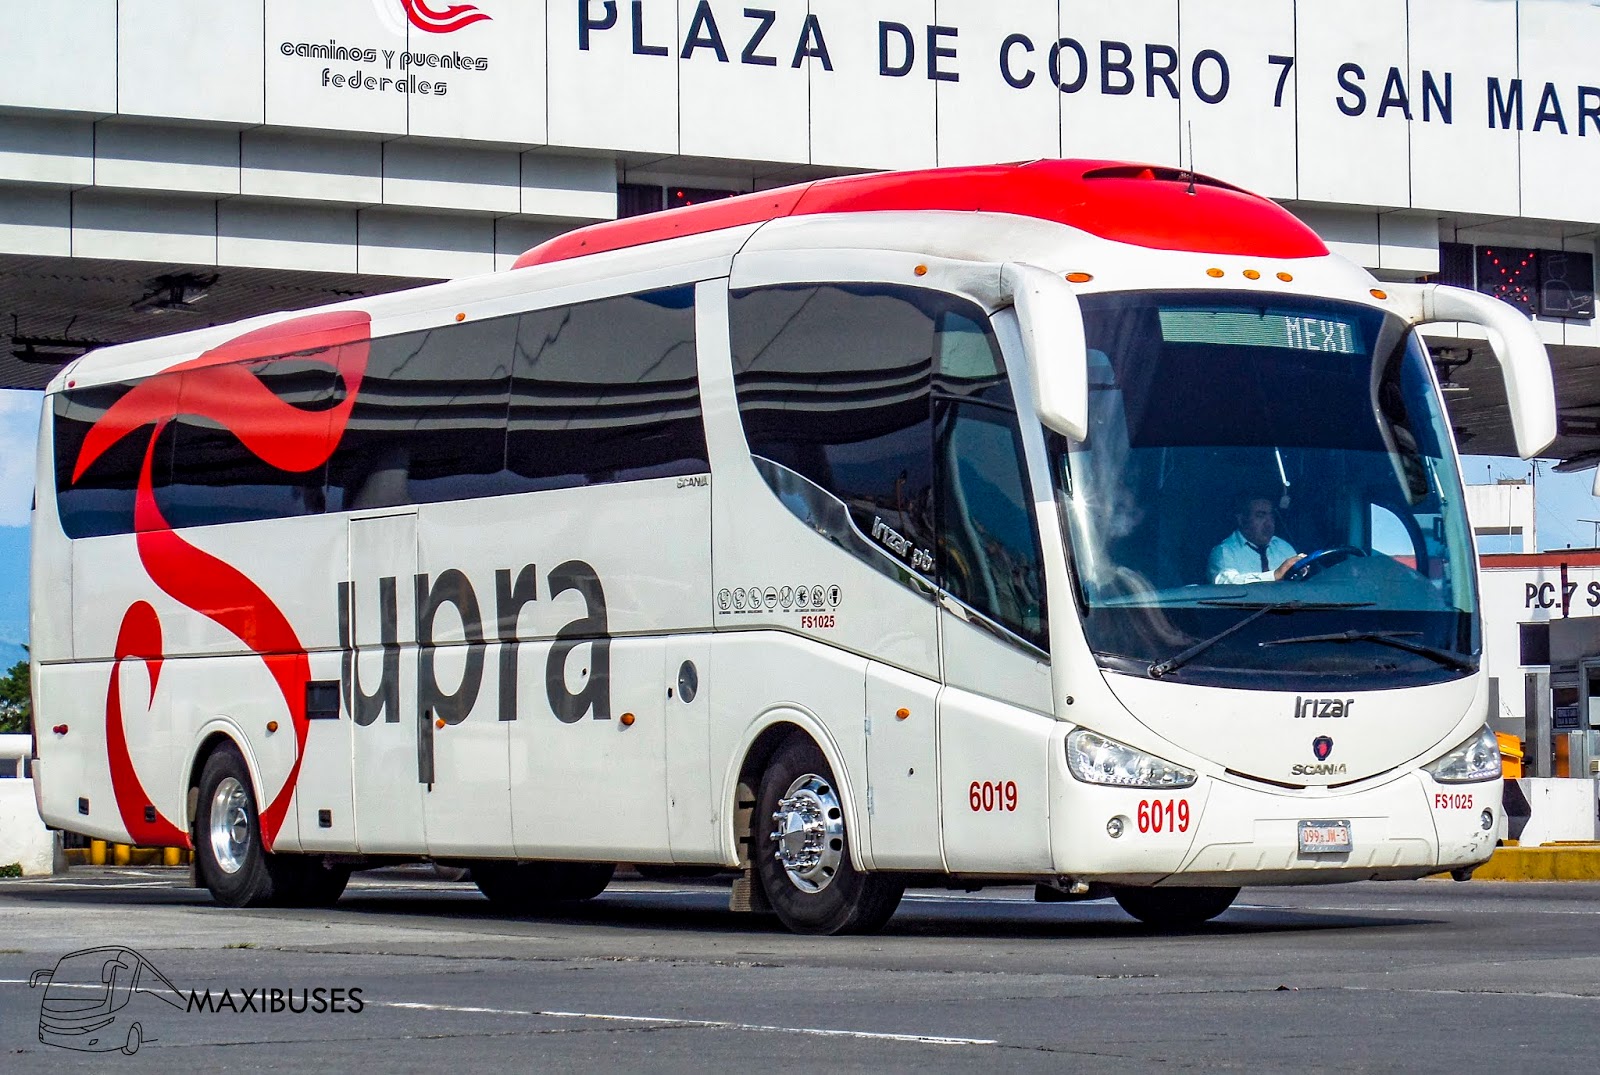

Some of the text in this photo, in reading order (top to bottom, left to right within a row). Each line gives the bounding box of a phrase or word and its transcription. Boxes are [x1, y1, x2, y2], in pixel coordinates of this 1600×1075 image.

[280, 39, 377, 63] caminos
[399, 51, 489, 71] puentes
[579, 0, 834, 72] PLAZA
[878, 20, 960, 82] DE
[999, 33, 1230, 105] COBRO
[1268, 55, 1295, 107] 7
[1336, 62, 1453, 125] SAN
[321, 68, 448, 96] federales
[801, 615, 835, 628] FS1025
[1294, 695, 1355, 718] Irizar
[1291, 764, 1347, 775] SCANIA
[969, 781, 1018, 812] 6019
[1435, 793, 1473, 809] FS1025
[1137, 799, 1190, 833] 6019
